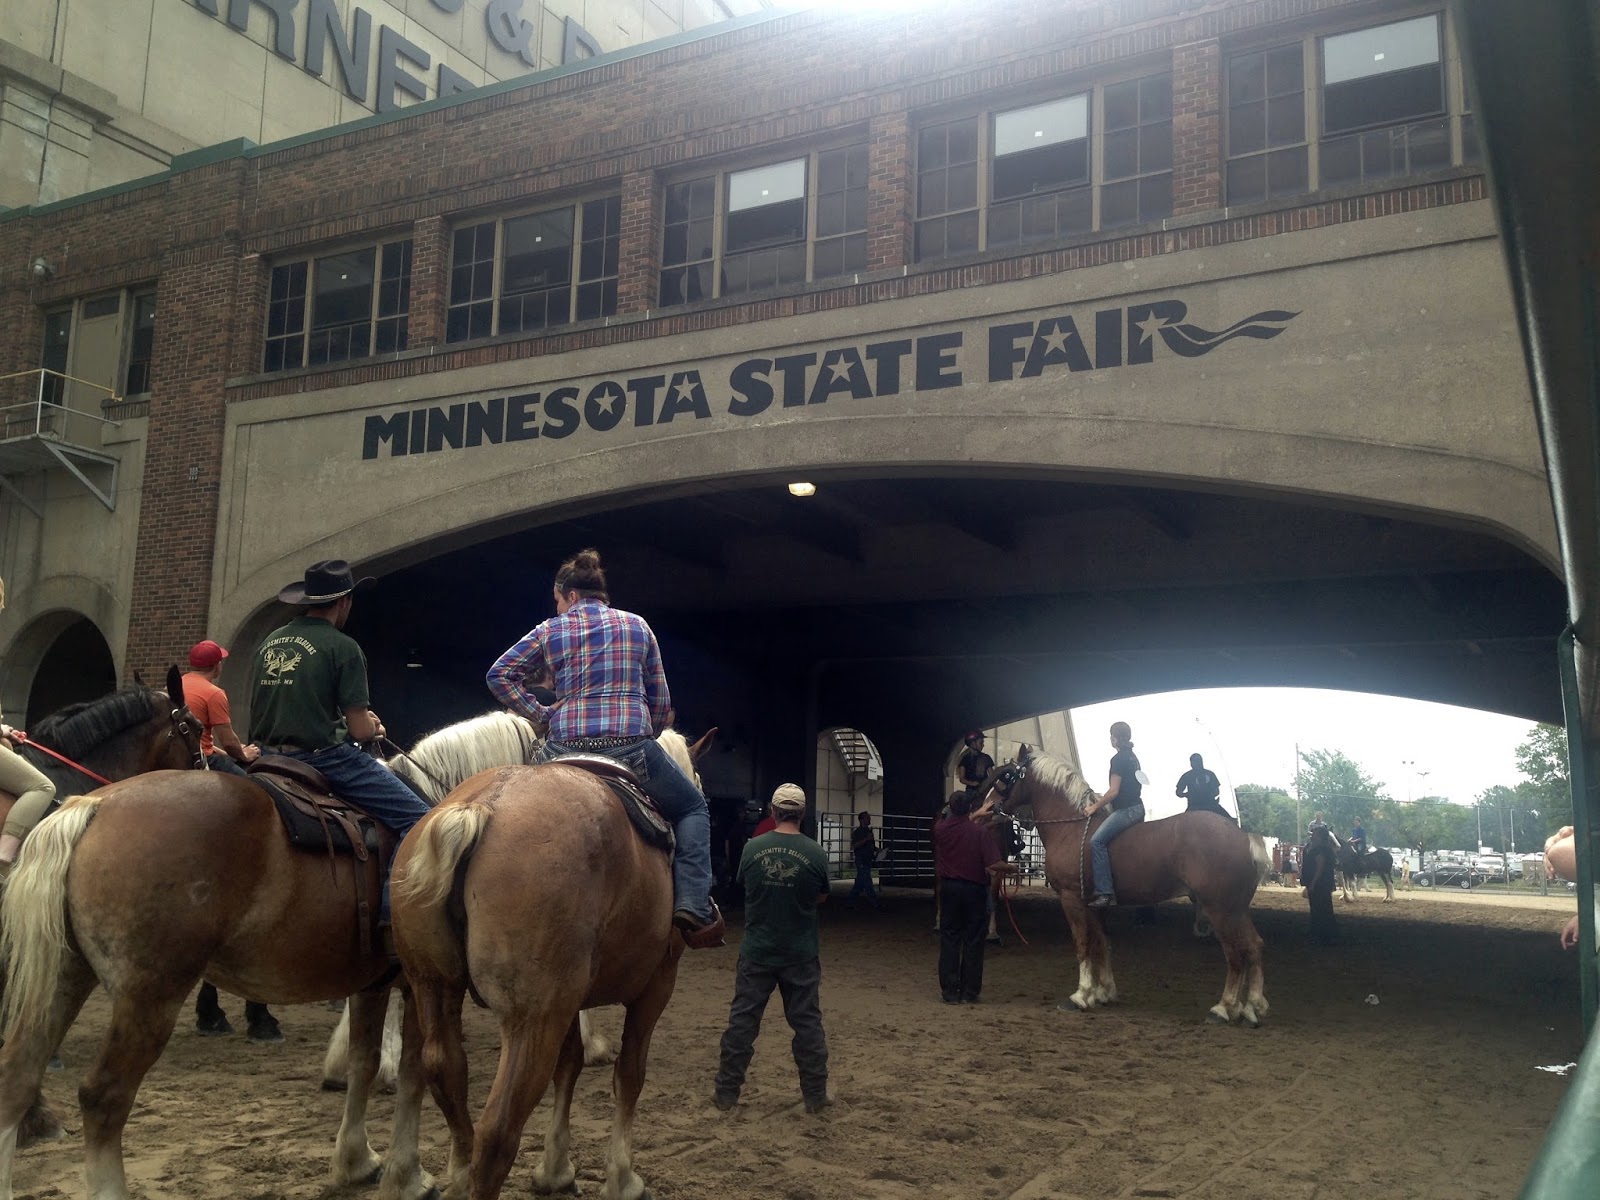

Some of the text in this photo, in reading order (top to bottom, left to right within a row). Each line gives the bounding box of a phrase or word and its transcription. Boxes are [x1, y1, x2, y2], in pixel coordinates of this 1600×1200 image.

[362, 299, 1304, 460] MINNESOTA STATE FAIR
